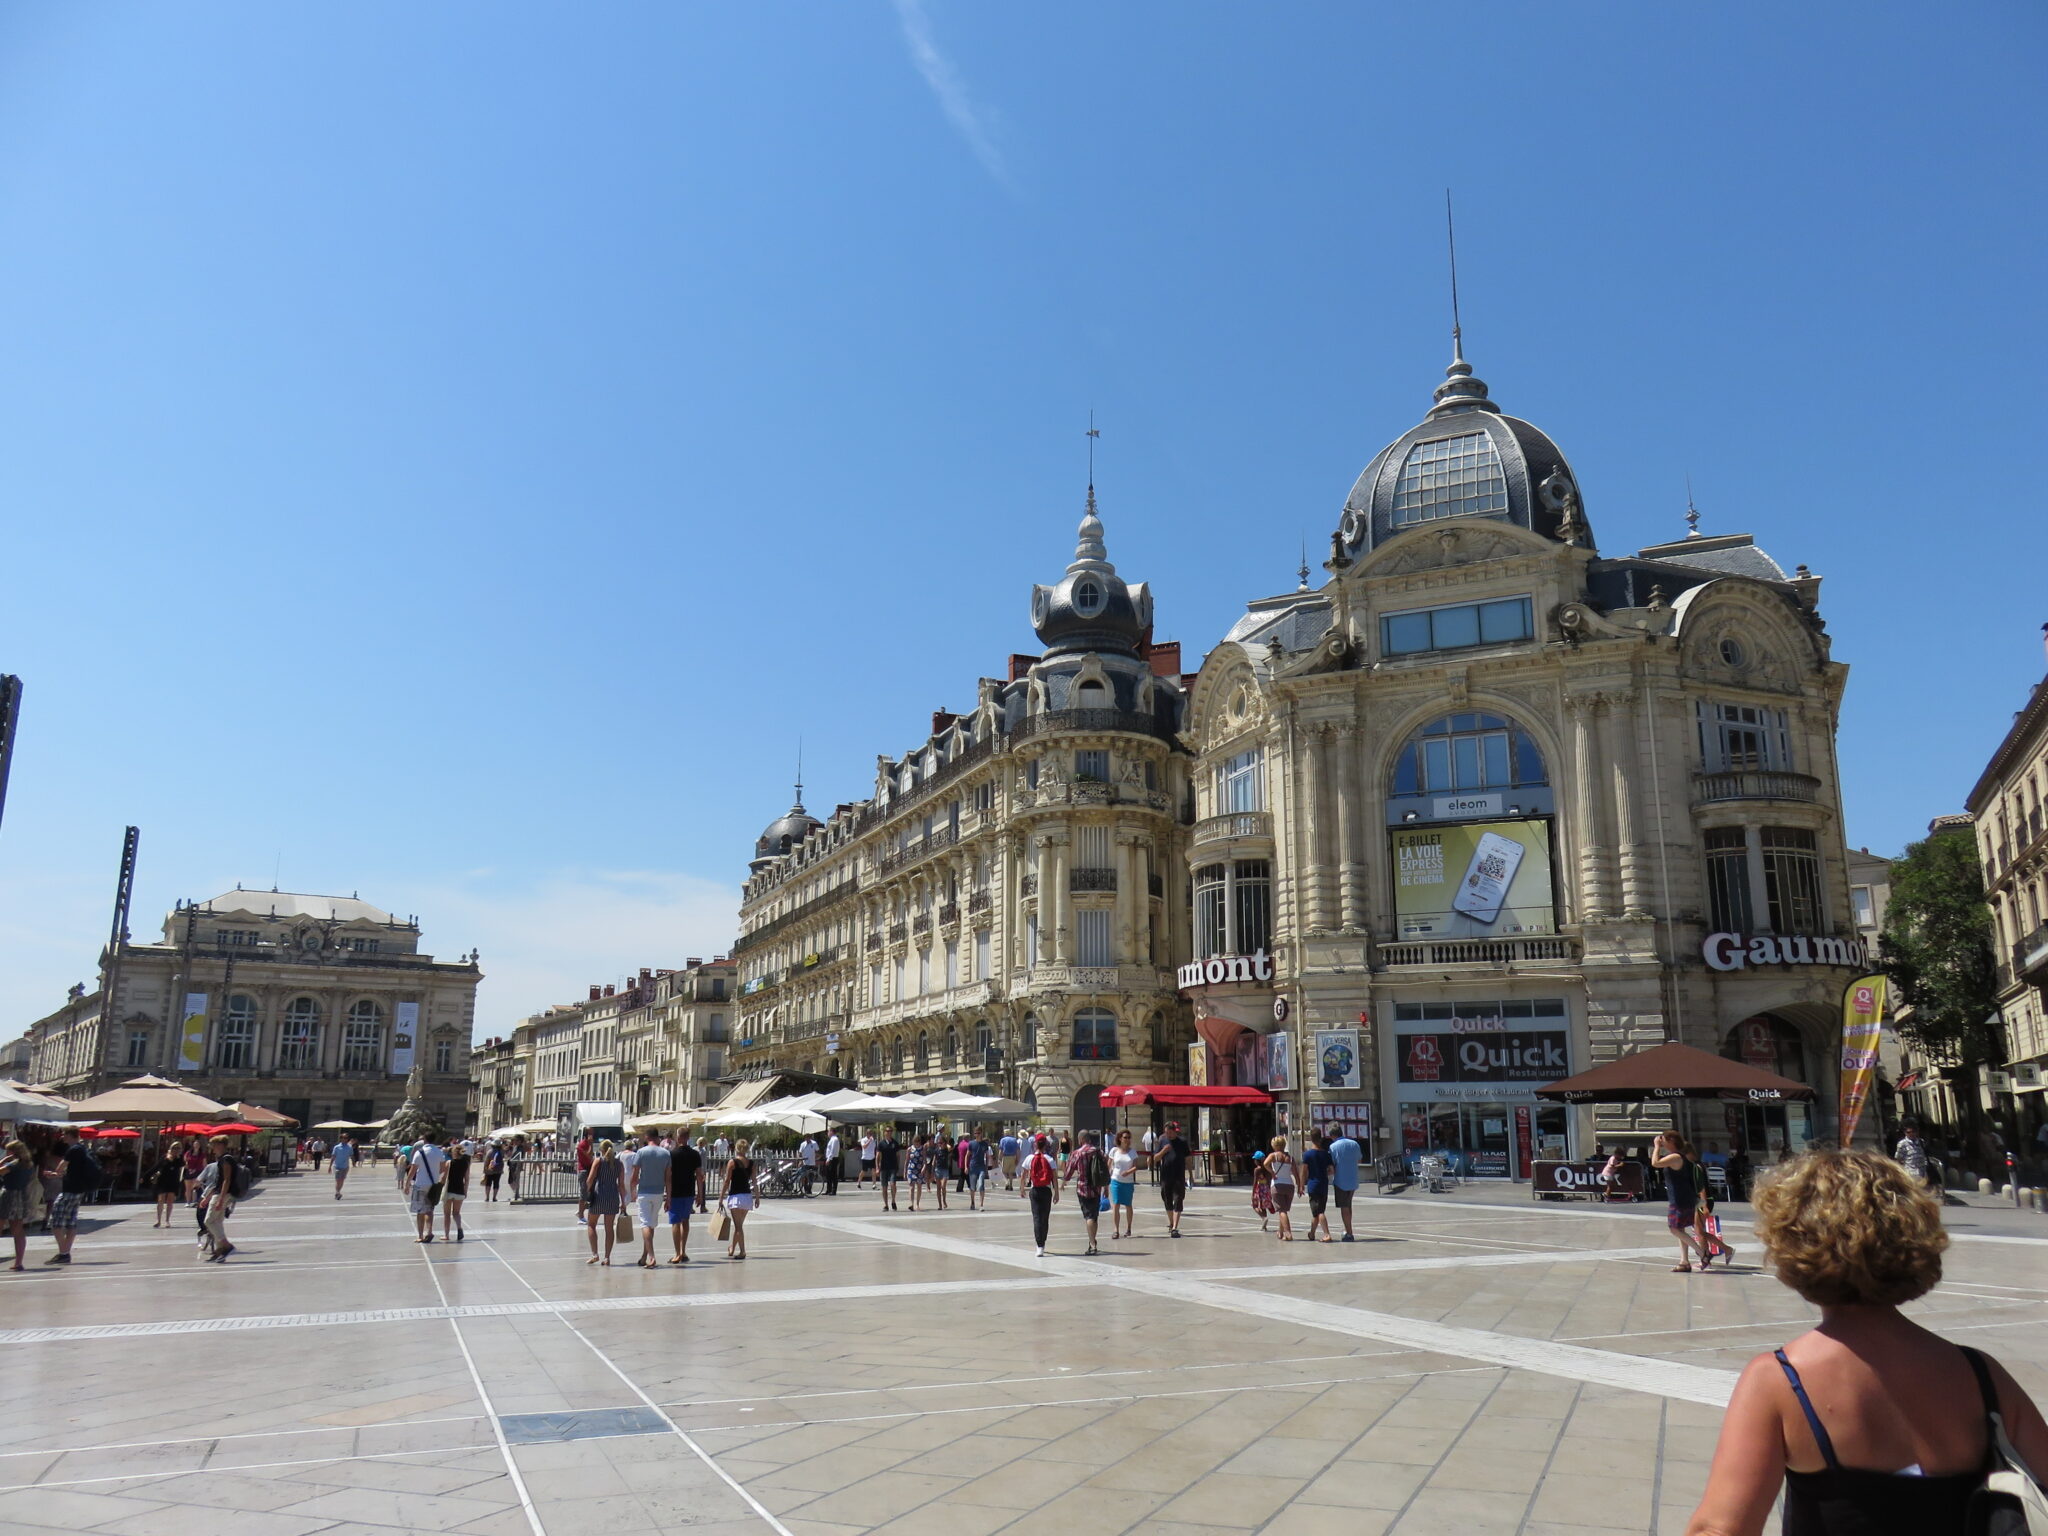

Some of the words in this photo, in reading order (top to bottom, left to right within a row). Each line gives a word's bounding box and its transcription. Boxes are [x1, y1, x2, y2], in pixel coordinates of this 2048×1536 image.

[1448, 799, 1487, 810] eleom
[1399, 834, 1441, 848] E-BILLET
[1399, 847, 1413, 860] LA
[1416, 845, 1443, 858] VOIE
[1400, 858, 1443, 870] EXPRESS
[1400, 876, 1412, 886] DE
[1857, 989, 1871, 1003] Q
[1451, 1015, 1506, 1034] Quick
[1415, 1040, 1436, 1061] Q
[1460, 1039, 1566, 1072] Quick
[1509, 1069, 1567, 1077] Restaurant
[1564, 1090, 1593, 1100] Quick
[1654, 1088, 1685, 1097] Quick
[1748, 1088, 1781, 1099] Quick
